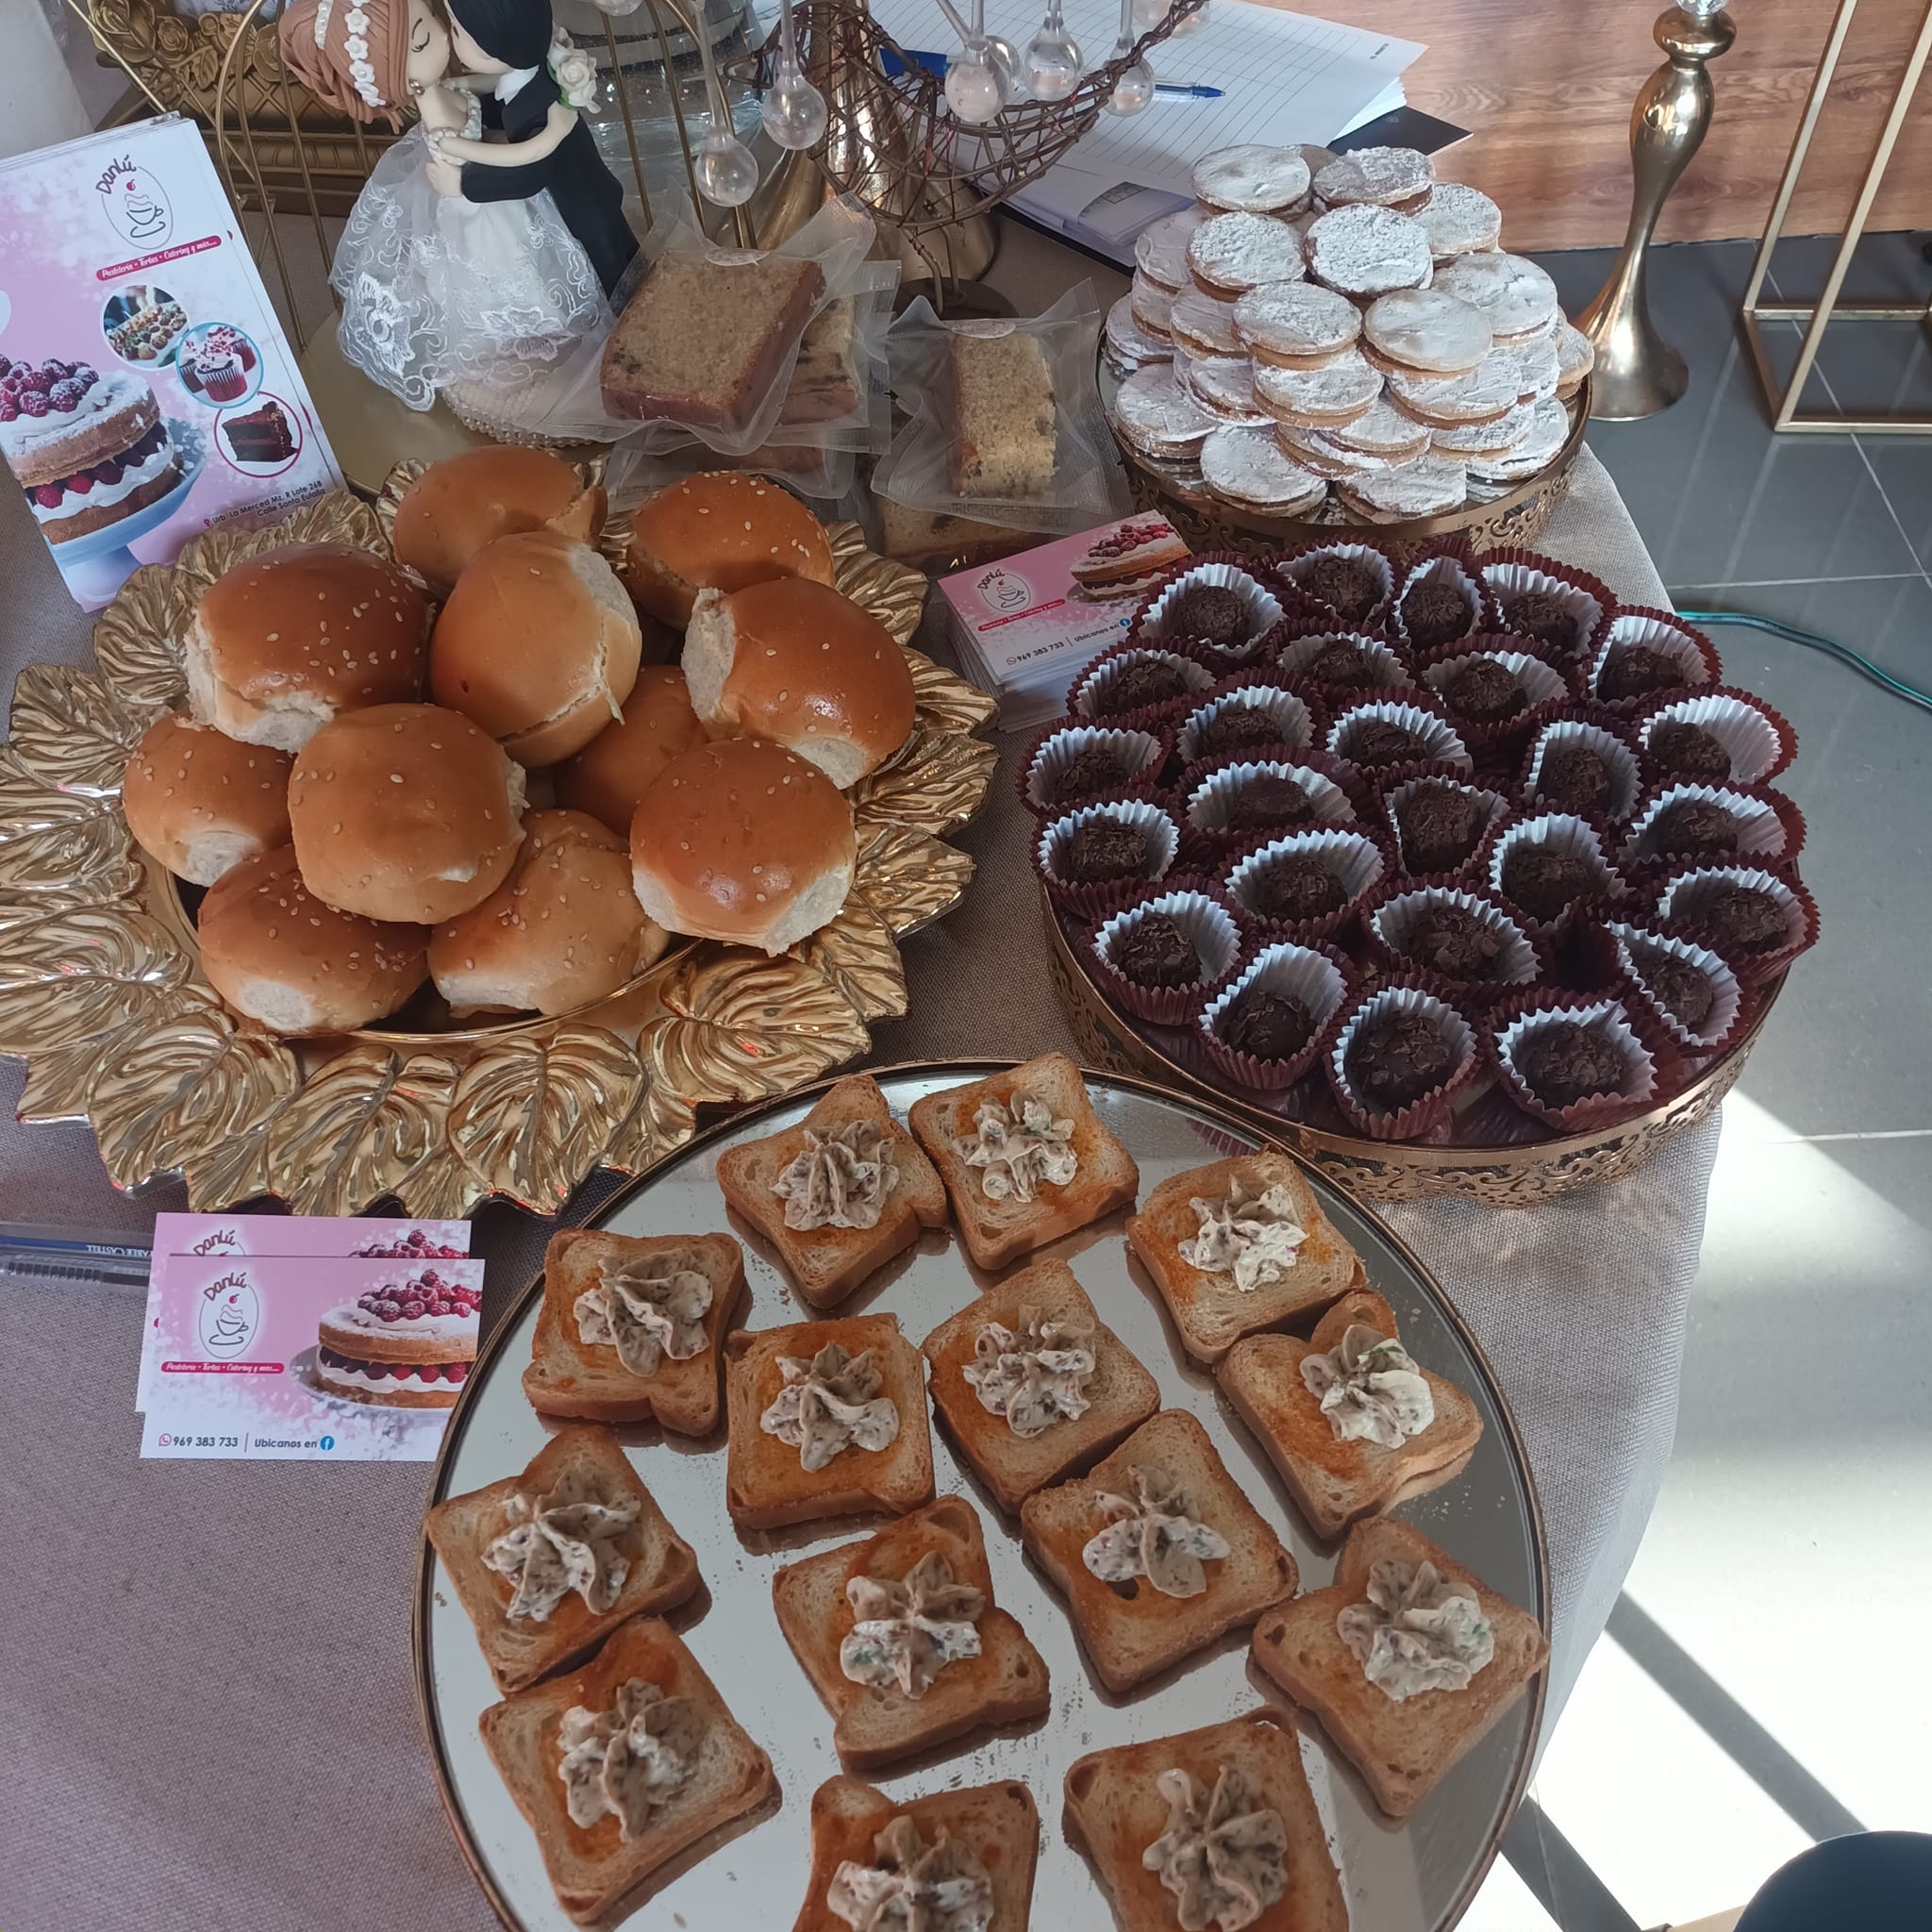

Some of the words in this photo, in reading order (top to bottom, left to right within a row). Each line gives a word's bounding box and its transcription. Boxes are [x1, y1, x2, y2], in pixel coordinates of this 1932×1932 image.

[95, 154, 137, 194] Danlú
[138, 256, 158, 268] Tortas
[163, 247, 190, 260] Catering
[229, 510, 240, 519] La
[240, 499, 270, 514] Merced
[291, 486, 308, 496] Lote
[257, 507, 277, 517] Calle
[278, 497, 301, 509] Santa
[301, 489, 325, 501] Eulalia
[1074, 627, 1109, 642] Ubicanos
[86, 1244, 153, 1257] ABER-CASTELL
[193, 1229, 236, 1257] Danlú
[203, 1272, 247, 1302] Danlú
[173, 1436, 192, 1447] 969
[195, 1436, 215, 1447] 383
[218, 1437, 239, 1447] 733
[254, 1438, 302, 1448] Ubicanos
[304, 1440, 318, 1448] en
